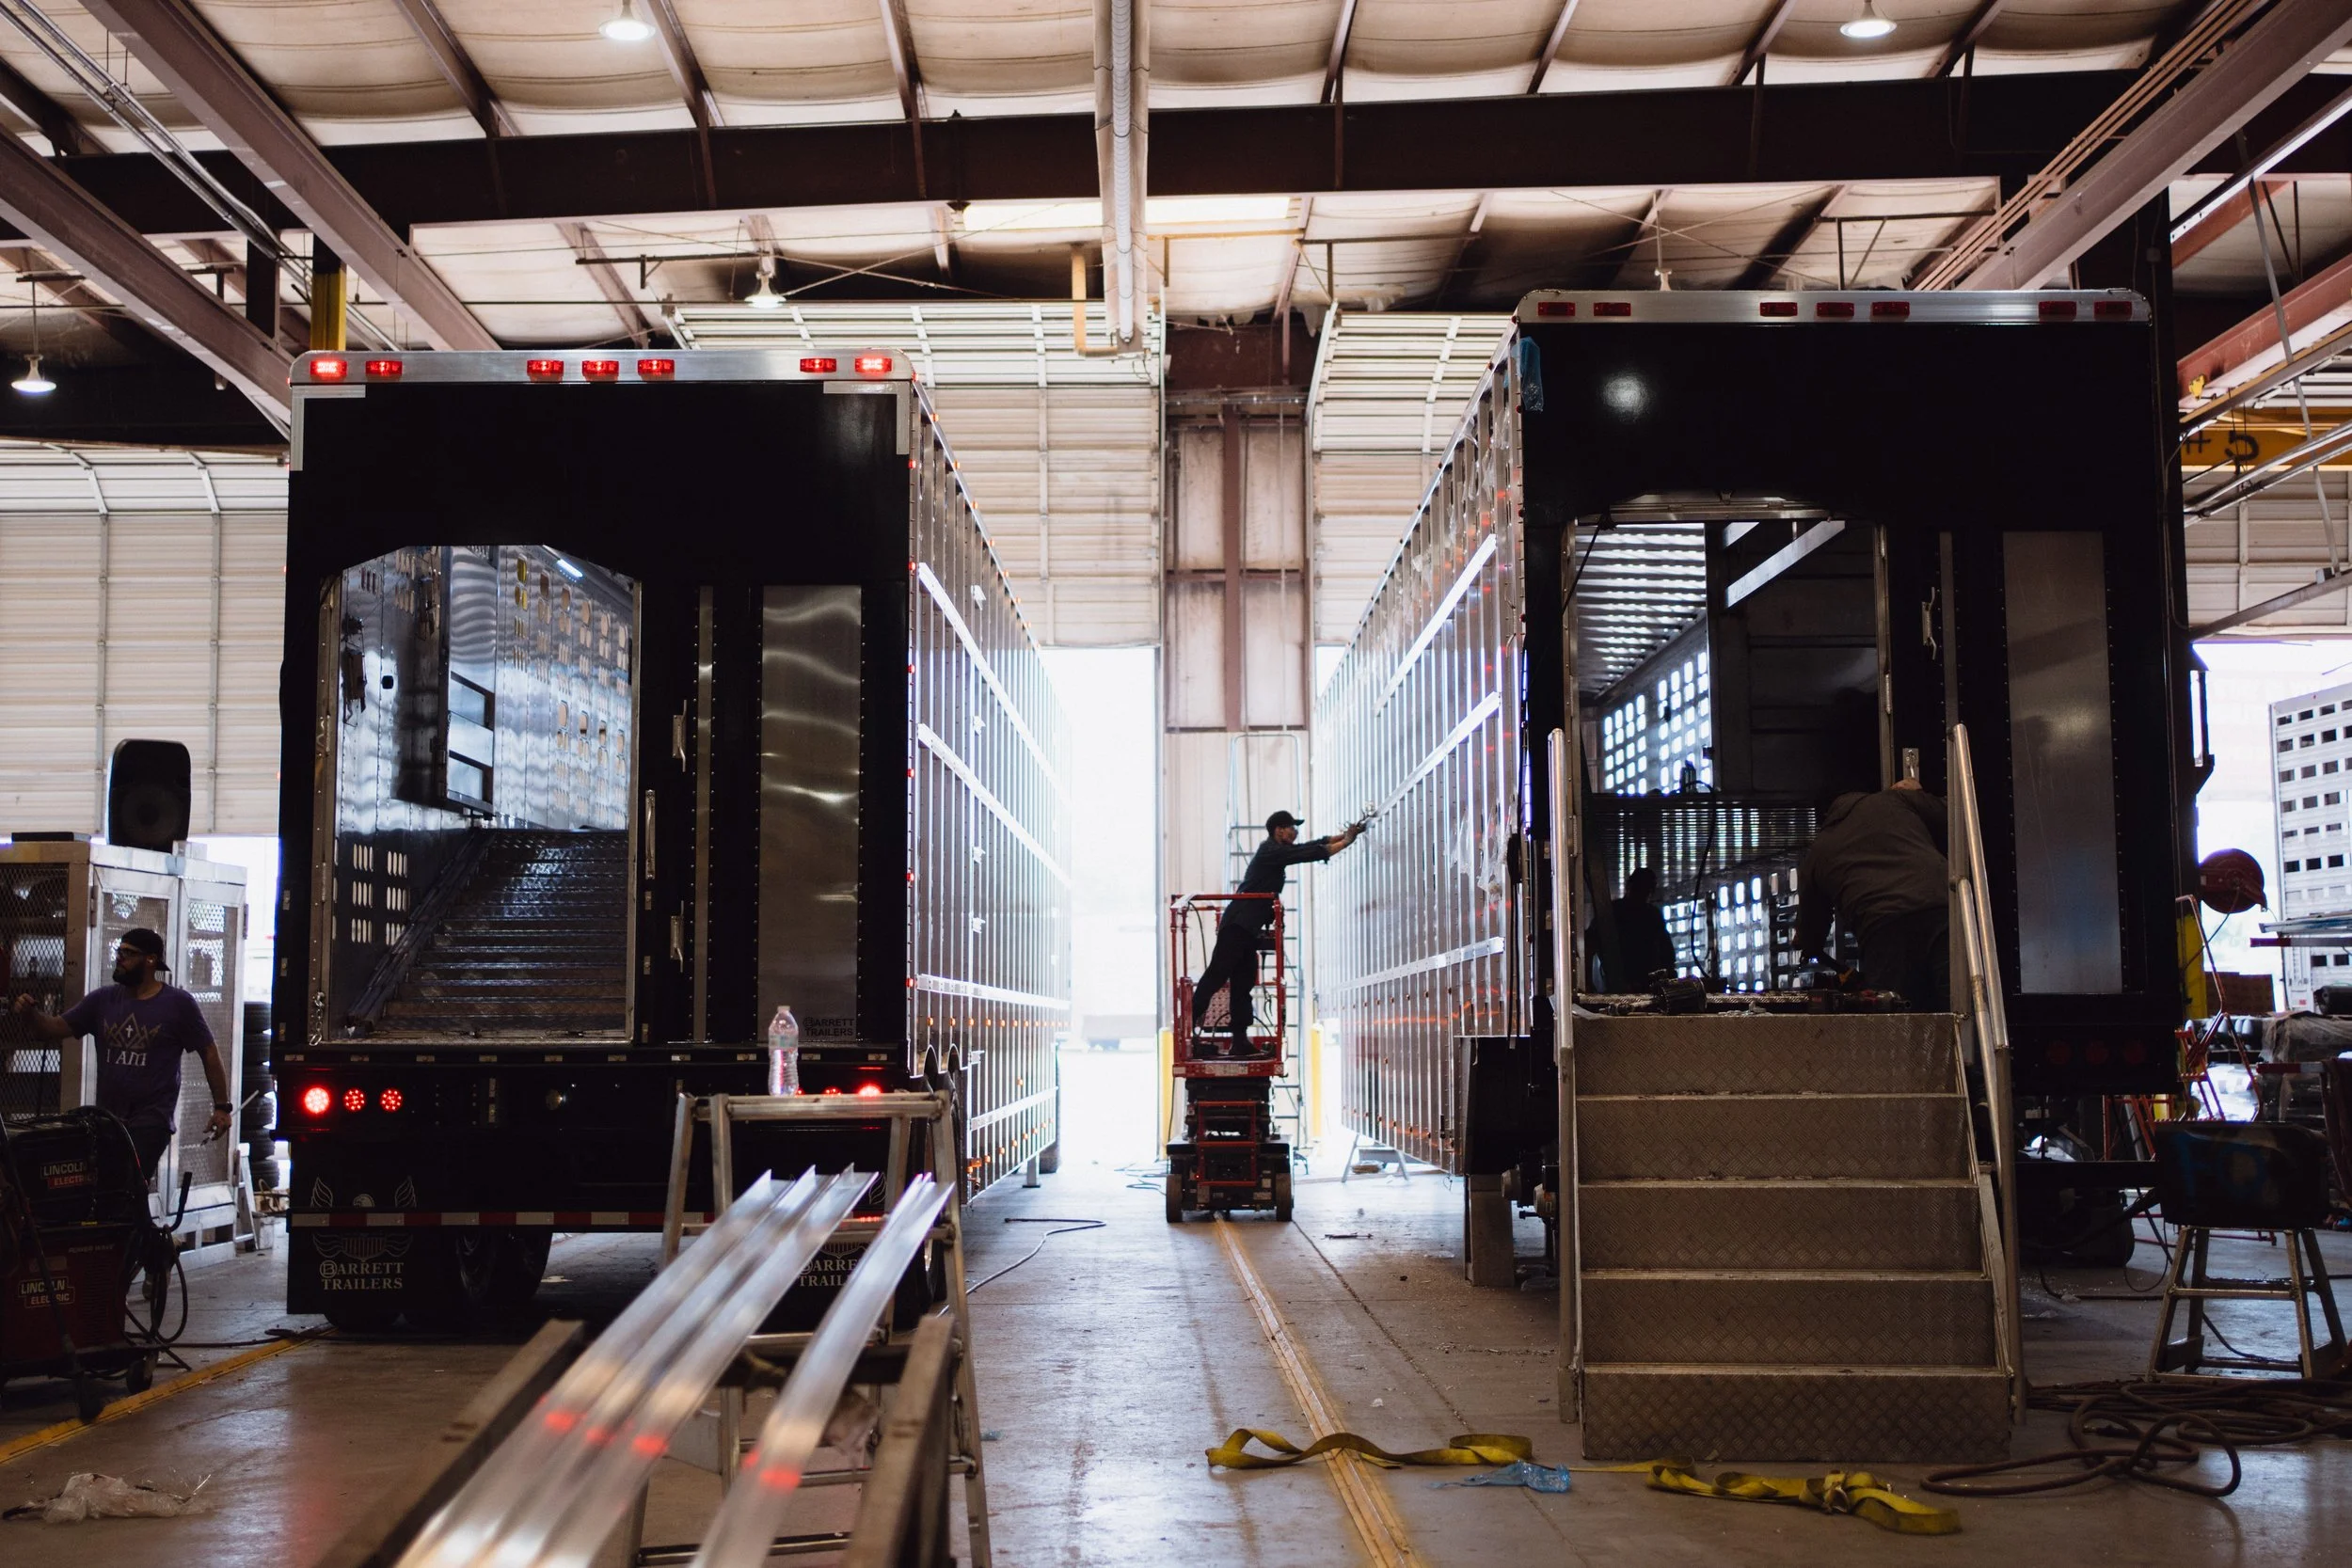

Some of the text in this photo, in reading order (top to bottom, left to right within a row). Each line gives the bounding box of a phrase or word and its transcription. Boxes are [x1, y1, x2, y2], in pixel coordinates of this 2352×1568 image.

[803, 1017, 854, 1027] BARRETT
[805, 1028, 853, 1037] TRAILERS
[106, 1049, 148, 1066] I AM
[320, 1260, 404, 1278] BARRETT
[21, 1279, 65, 1295] LINCLN
[322, 1277, 403, 1291] TRAILERS
[30, 1292, 70, 1305] ELECRIC
